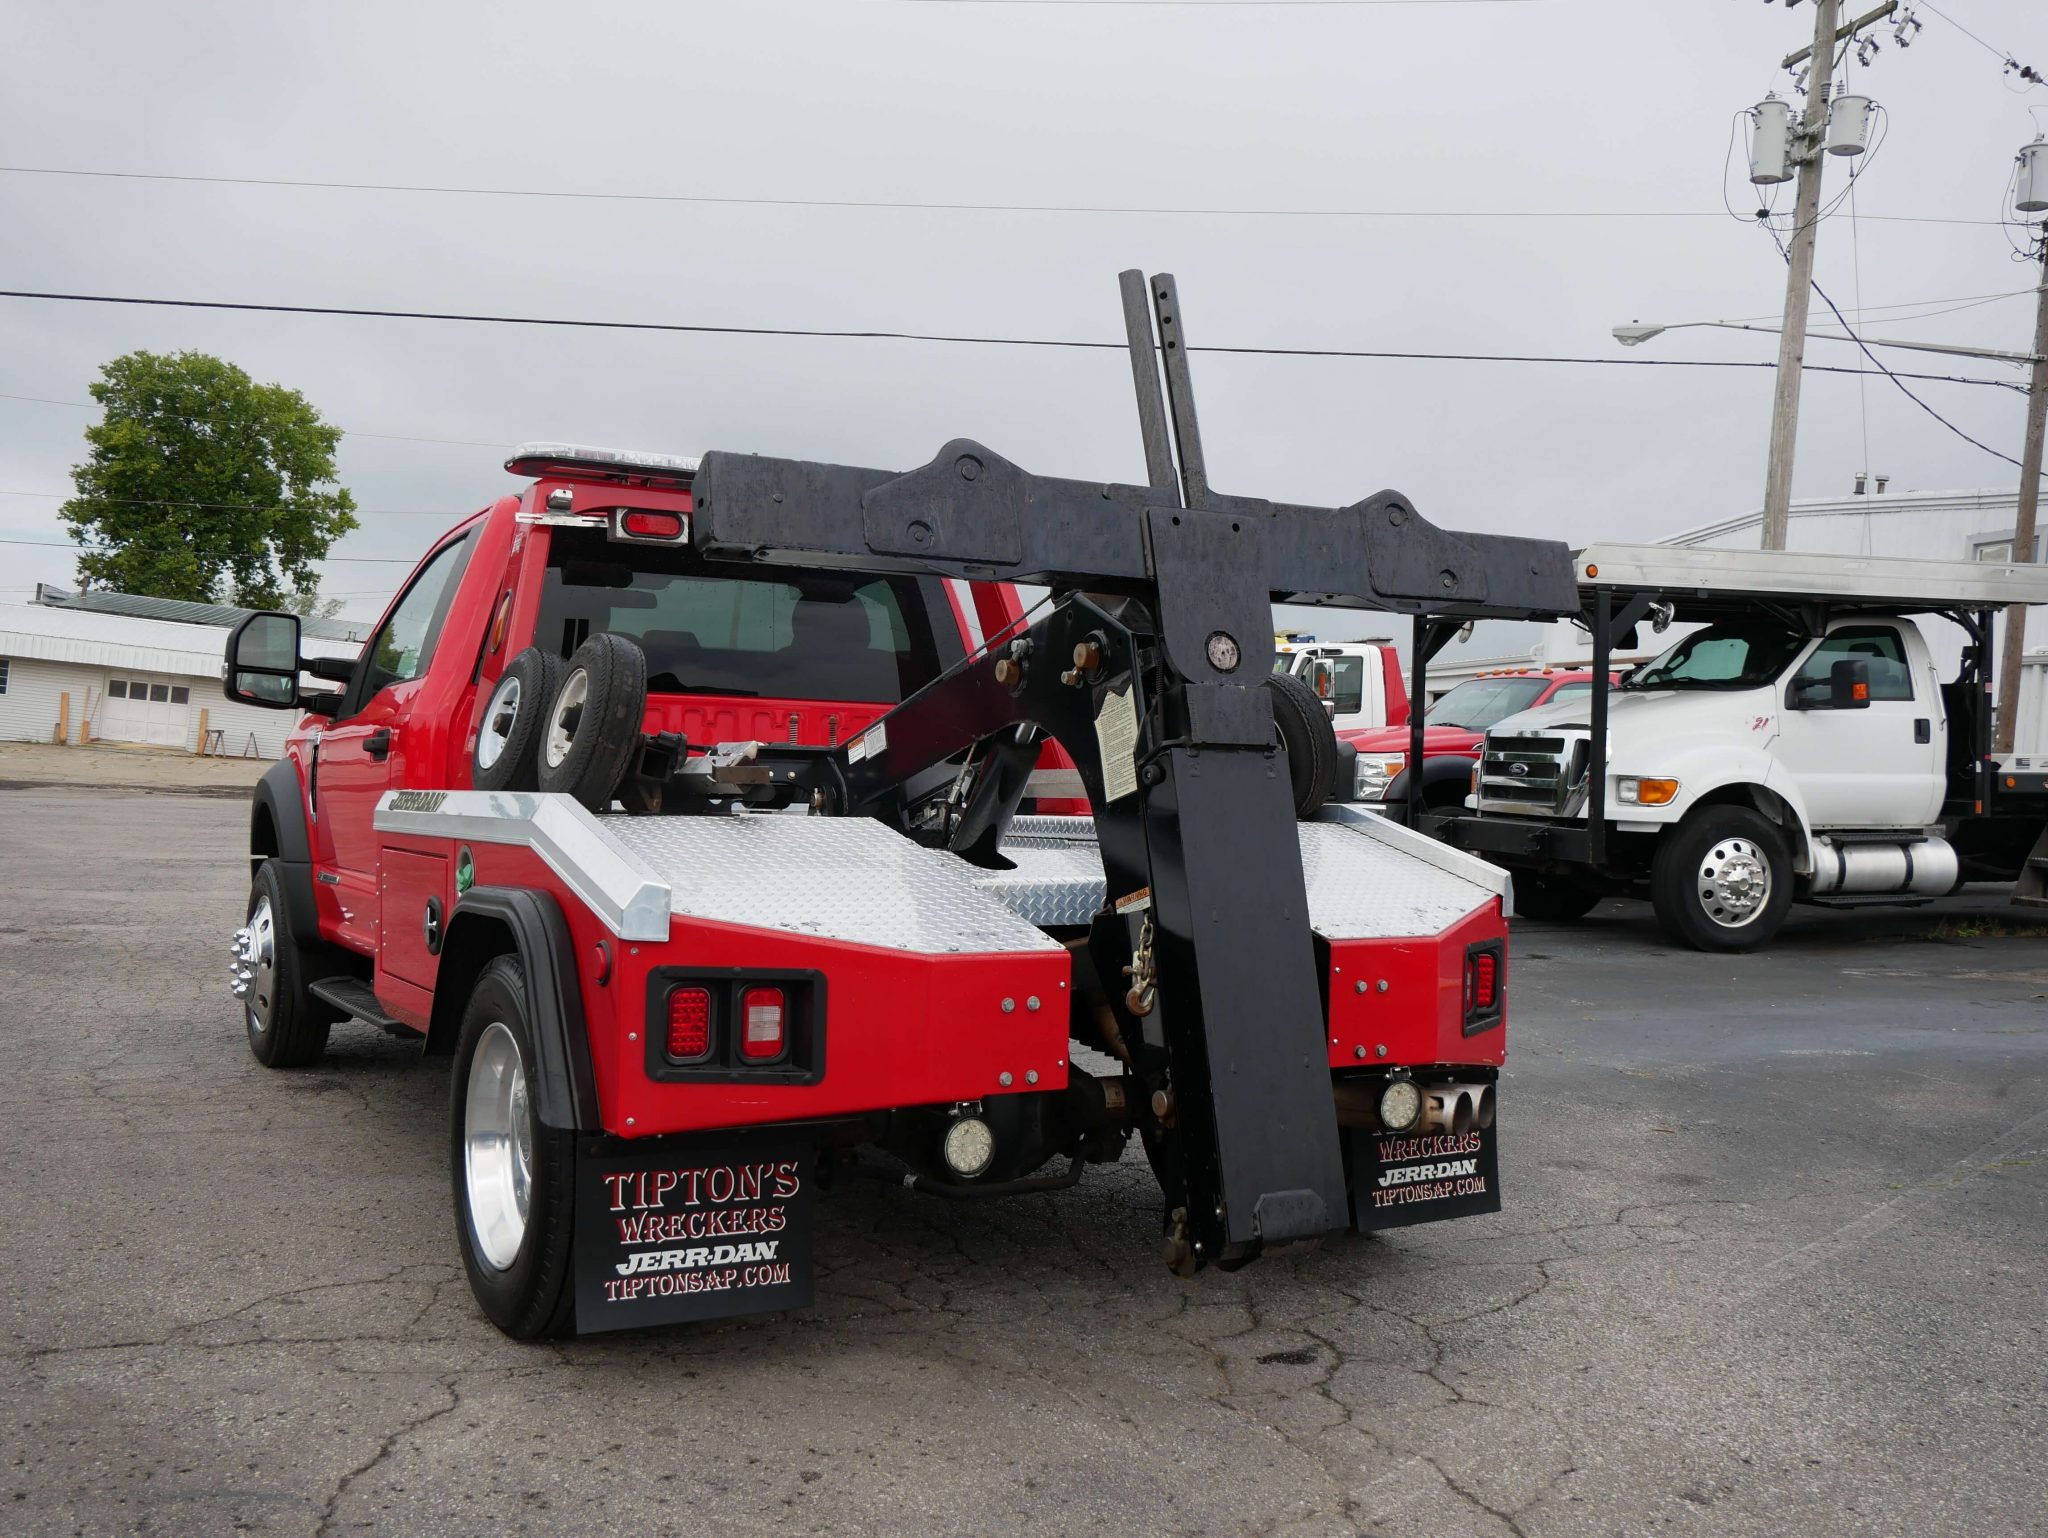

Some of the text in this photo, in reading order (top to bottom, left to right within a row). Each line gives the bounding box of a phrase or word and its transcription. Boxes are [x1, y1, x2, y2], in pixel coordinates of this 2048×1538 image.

[1379, 1131, 1481, 1162] WRECKERS
[602, 1161, 800, 1211] TIPTON'S
[1372, 1176, 1487, 1208] TIPTONSAP.COM
[616, 1206, 786, 1244] WRECKERS
[604, 1263, 791, 1301] TIPTONSAP.COM
